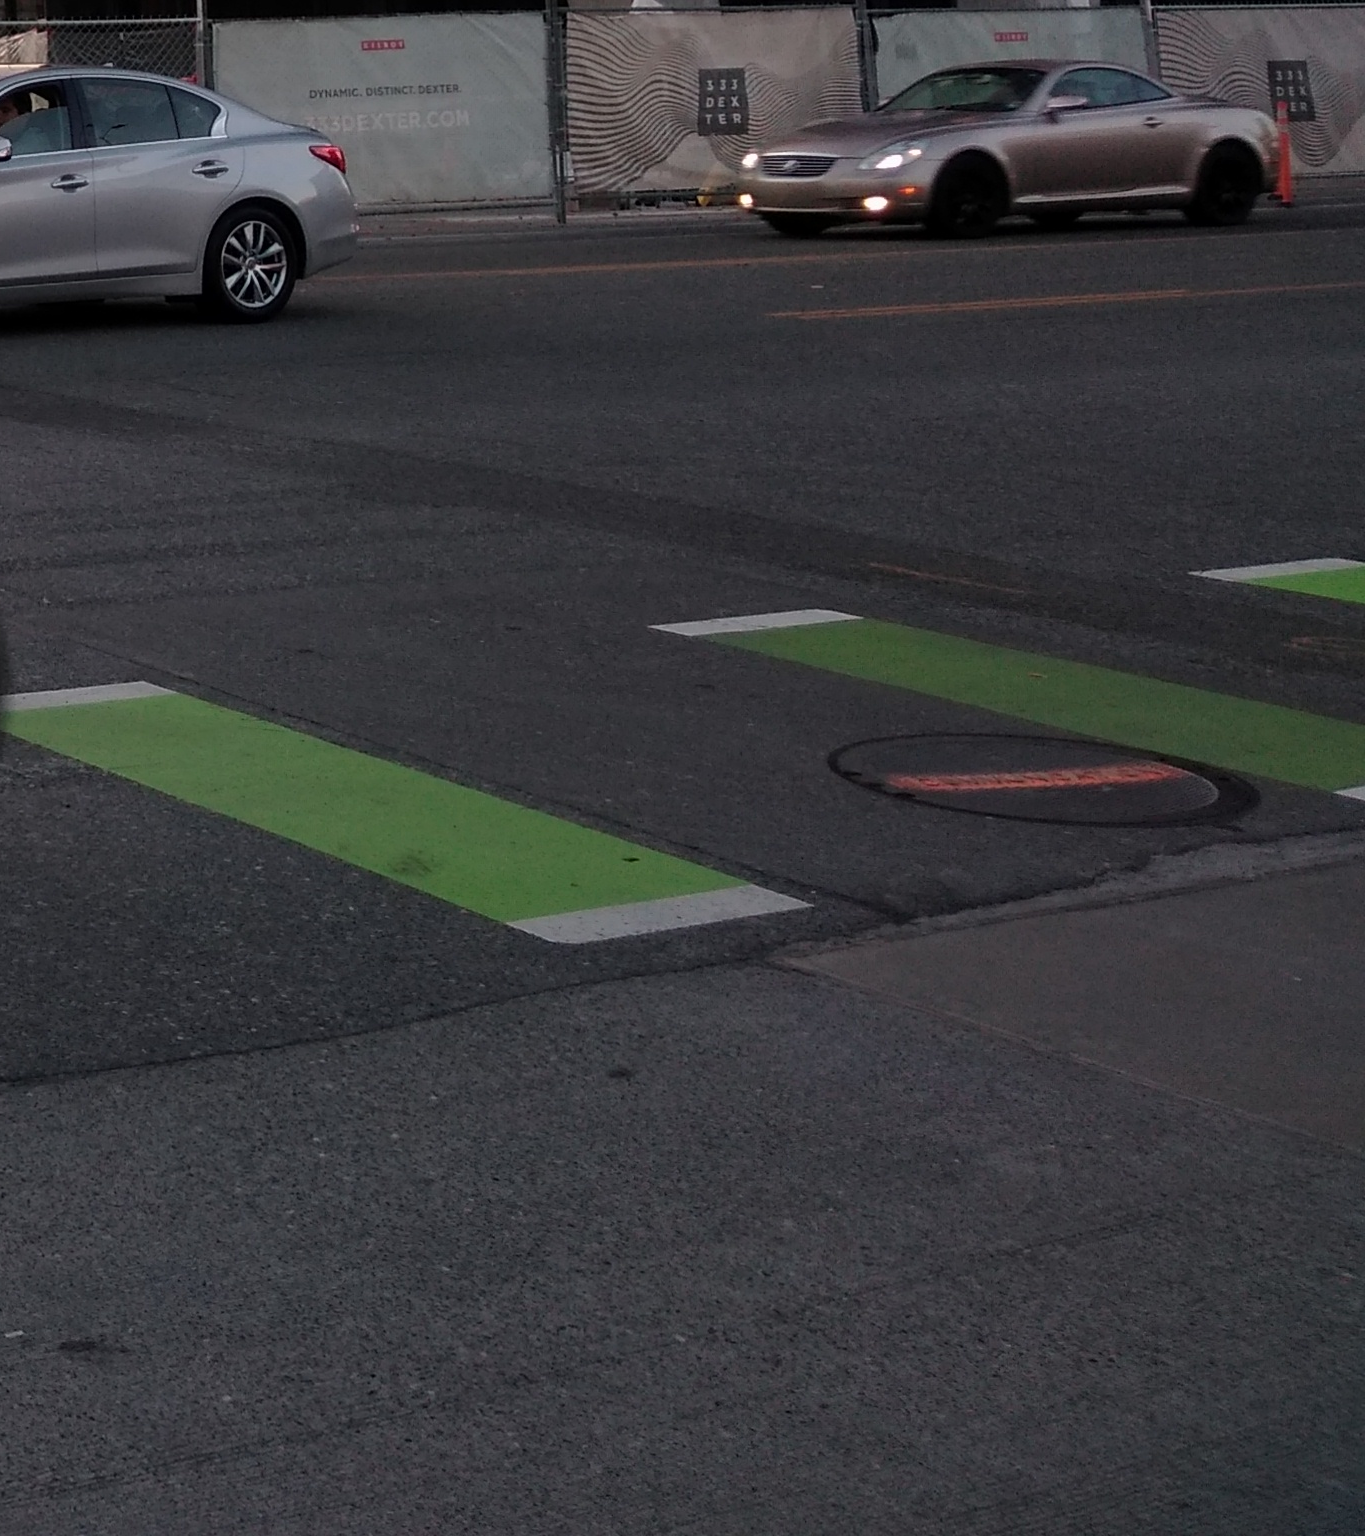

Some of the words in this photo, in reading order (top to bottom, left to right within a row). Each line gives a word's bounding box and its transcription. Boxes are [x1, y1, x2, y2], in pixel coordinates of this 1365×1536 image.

[1275, 70, 1304, 81] 333
[706, 79, 738, 91] 333
[309, 87, 363, 99] DYNAMIC.
[365, 85, 416, 97] DISTINCT.
[418, 84, 462, 94] DEXTER.
[1275, 86, 1307, 97] DEX
[705, 96, 740, 108] DEX
[1290, 101, 1307, 112] ER
[705, 113, 742, 125] TER
